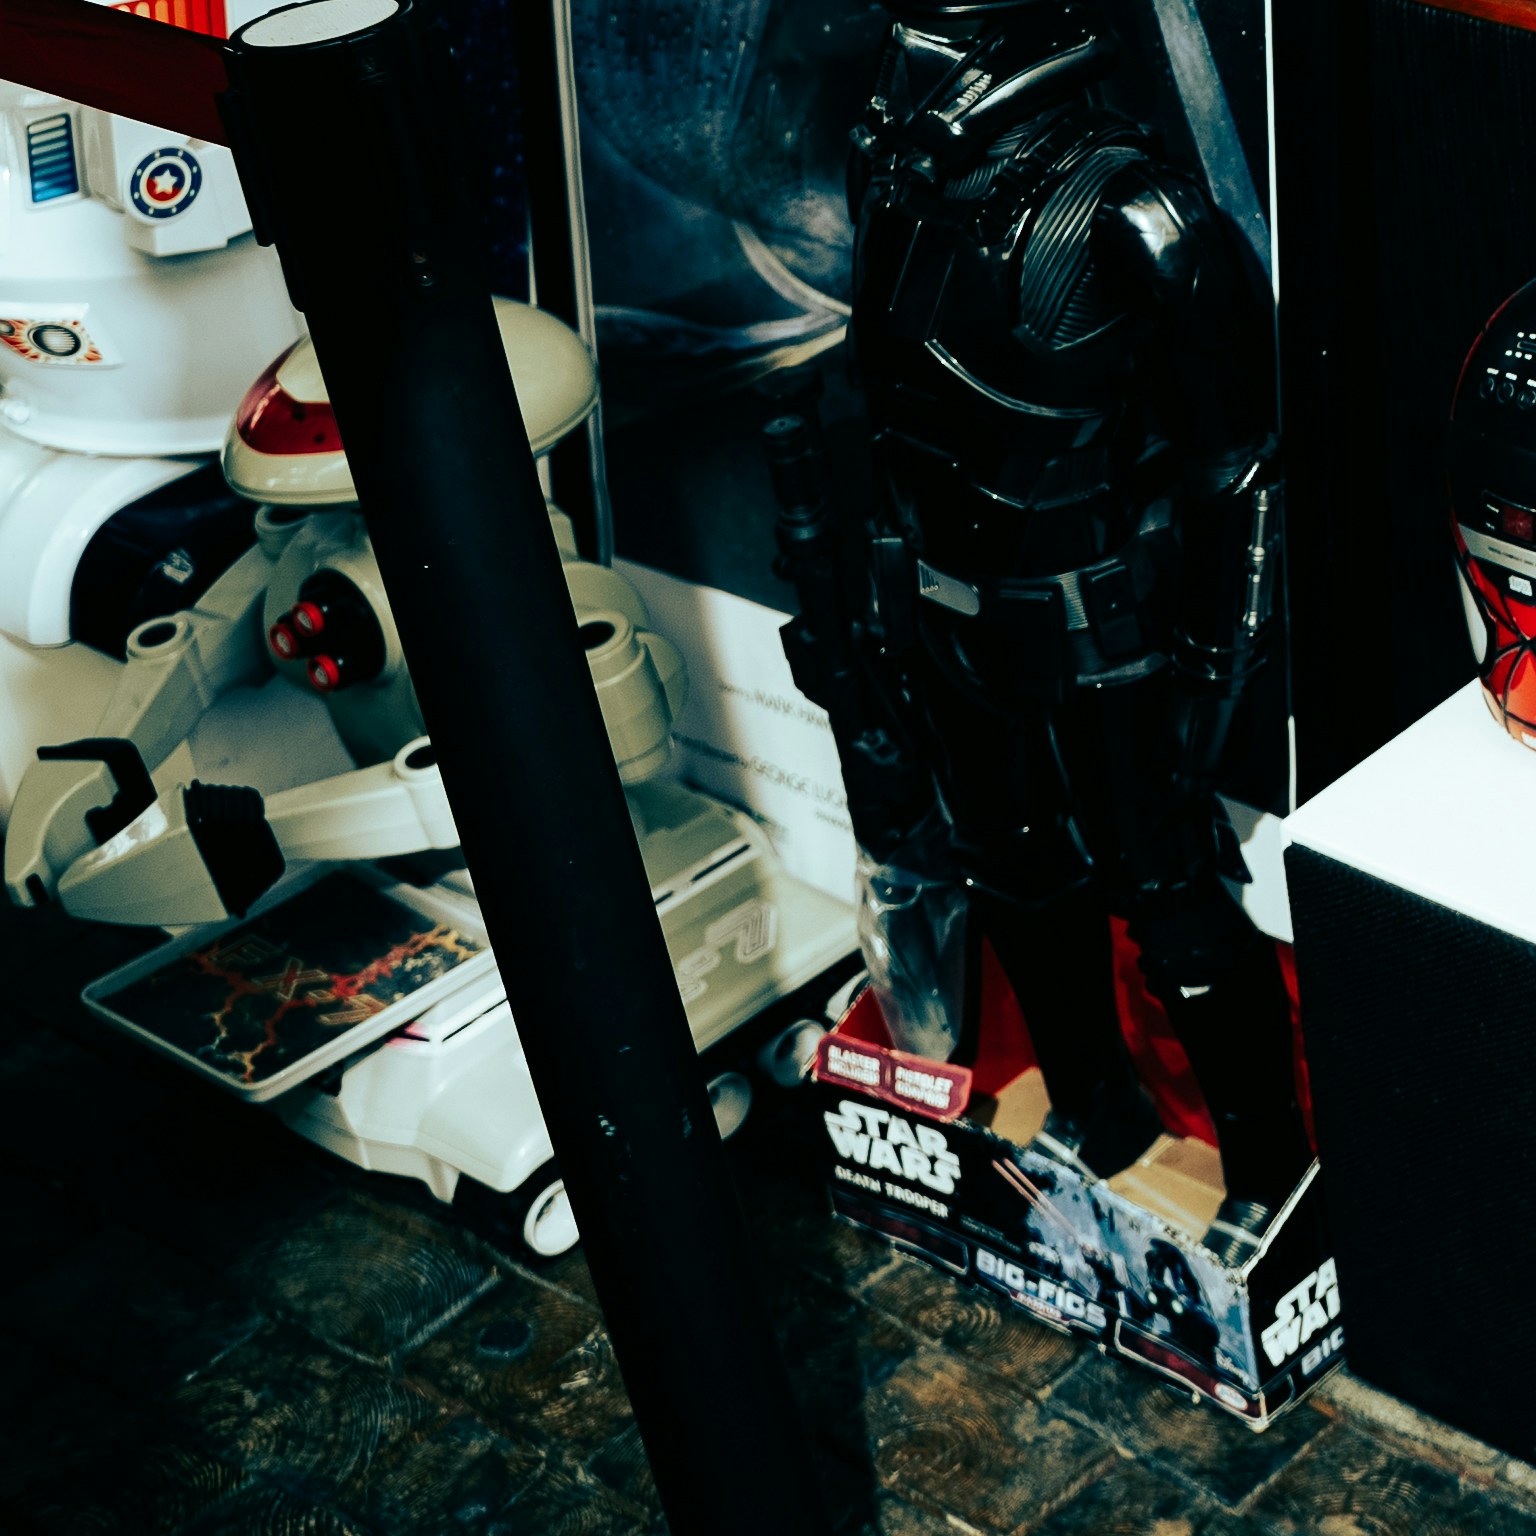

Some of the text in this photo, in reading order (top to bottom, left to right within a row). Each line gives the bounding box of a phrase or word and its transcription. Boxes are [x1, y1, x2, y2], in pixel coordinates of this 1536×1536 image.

[824, 1099, 960, 1164] STAR
[825, 1113, 962, 1195] WARS
[834, 1163, 950, 1218] DEATH TROOPER
[975, 1247, 1108, 1329] BIG-FIGS
